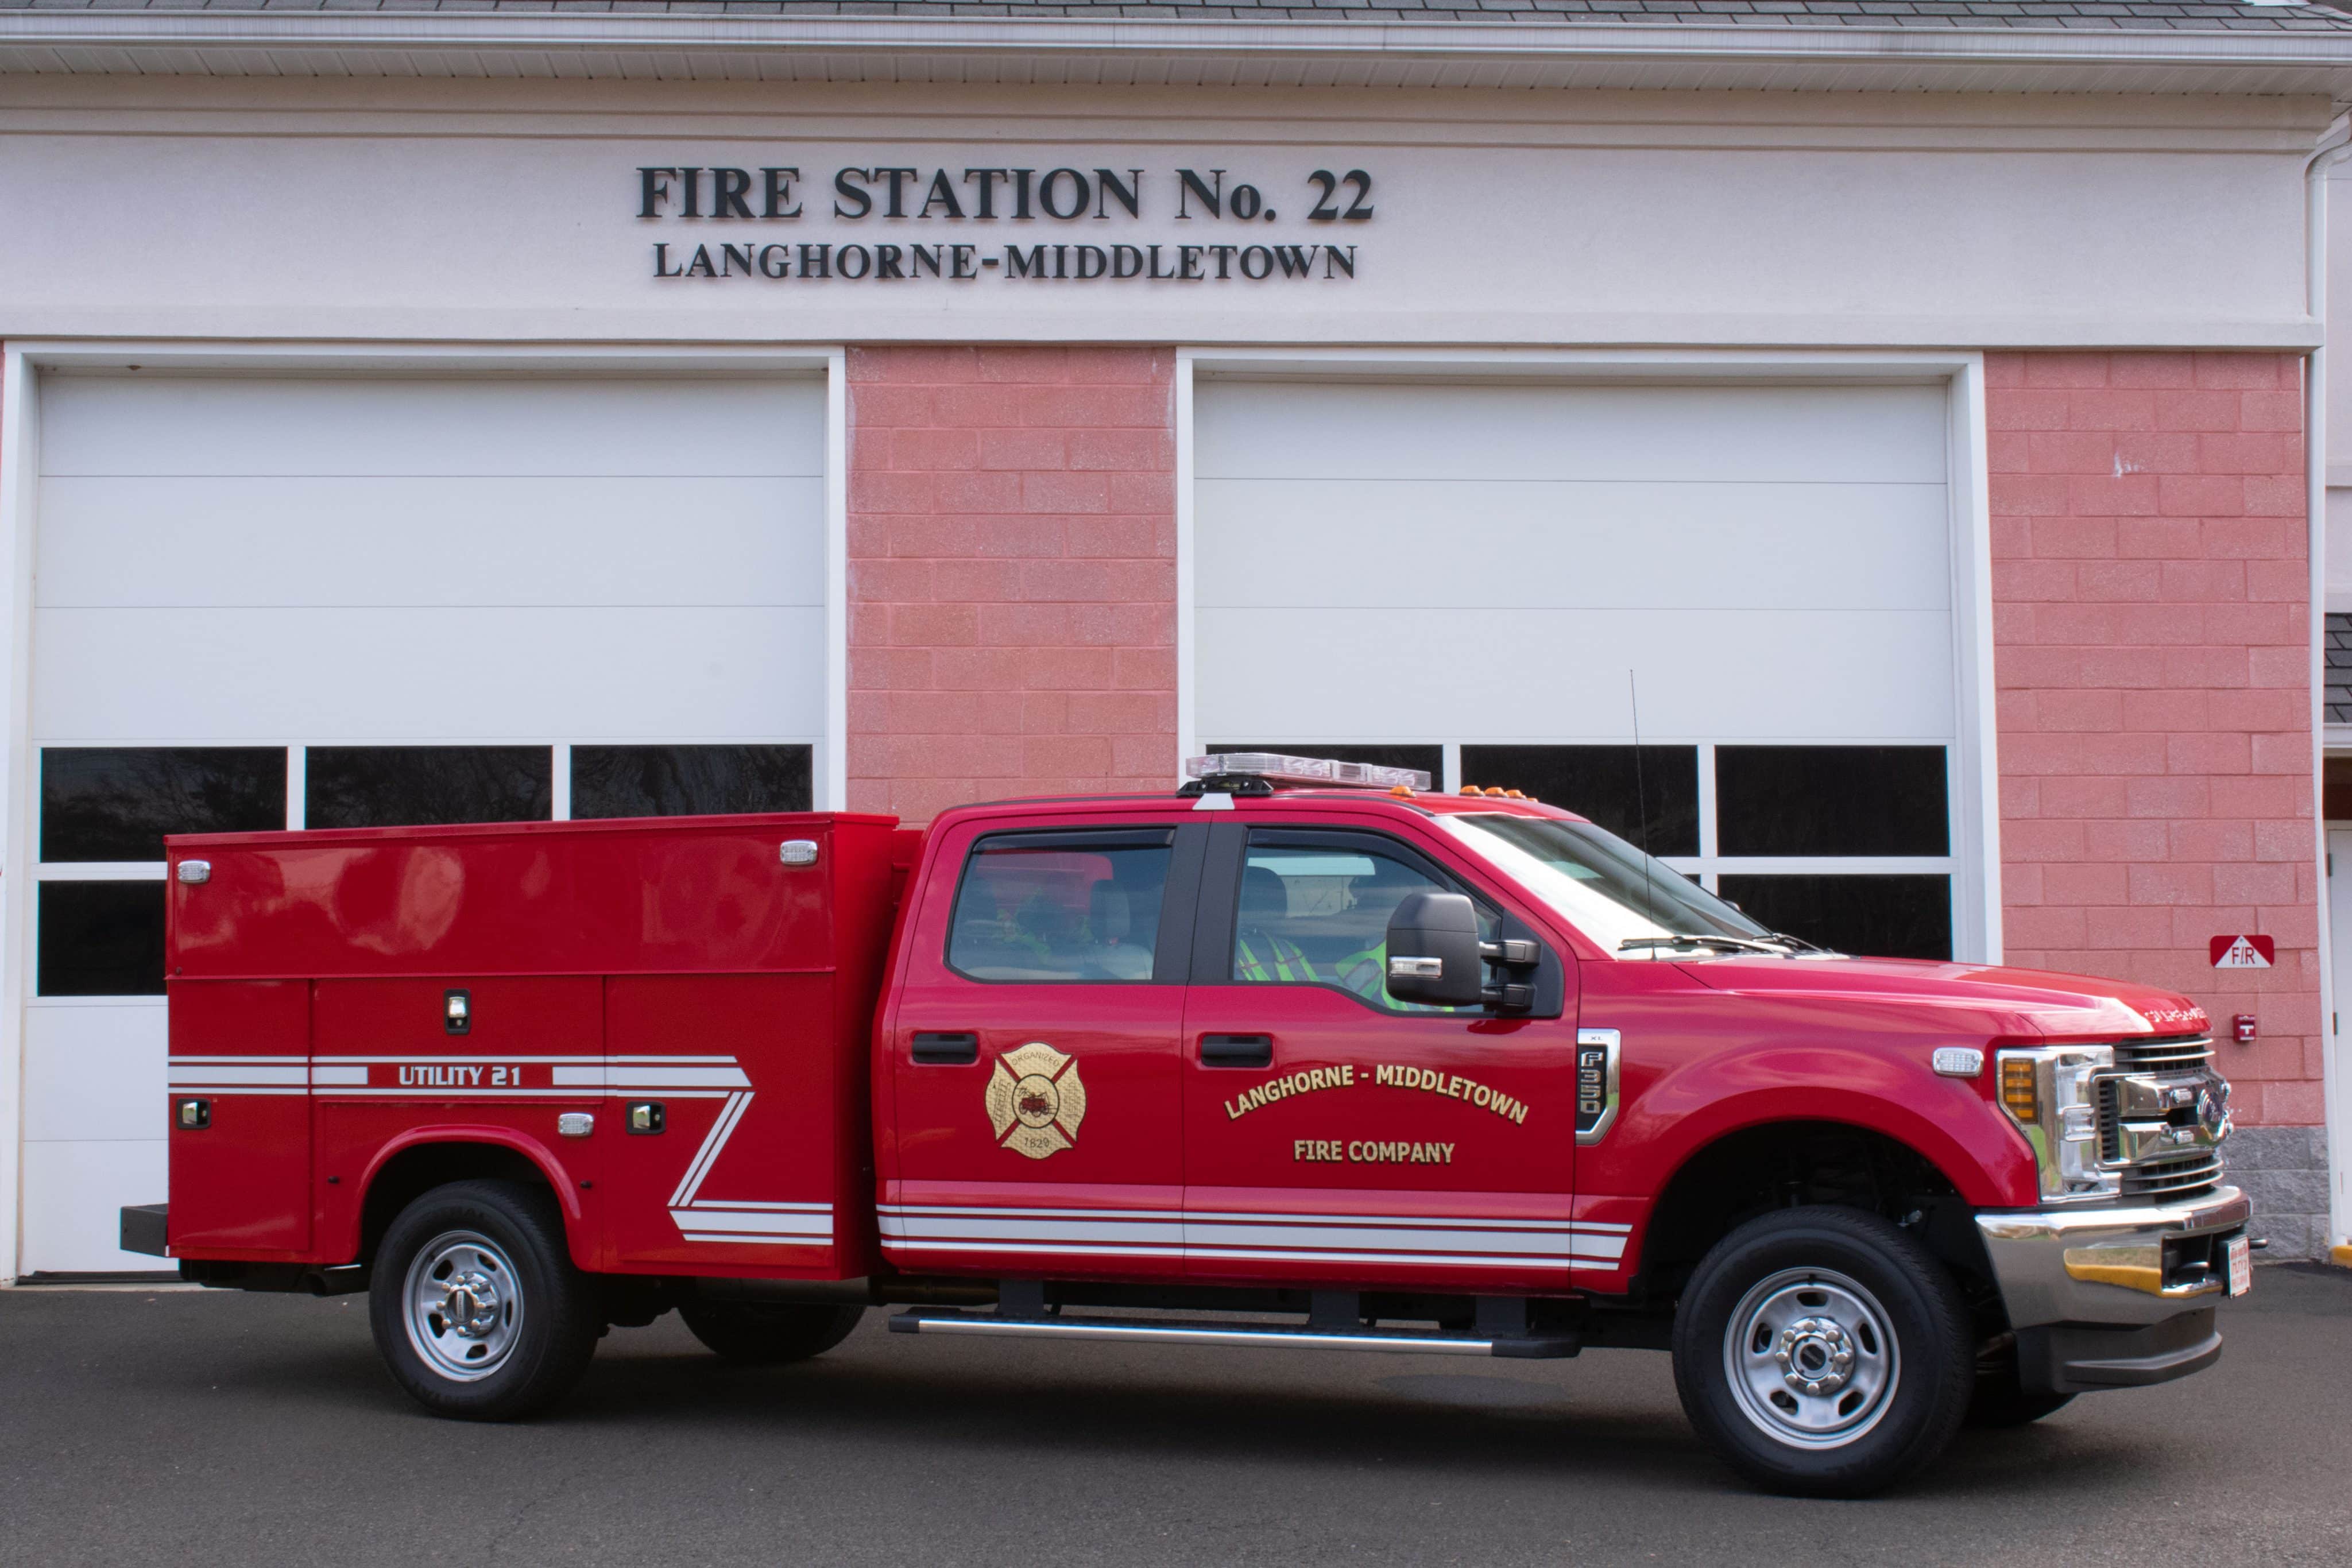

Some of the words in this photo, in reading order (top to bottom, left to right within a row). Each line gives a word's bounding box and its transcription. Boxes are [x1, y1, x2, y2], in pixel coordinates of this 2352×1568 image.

[635, 167, 803, 219] FIRE
[834, 167, 1145, 220] STATION
[1174, 169, 1276, 221] No.
[1306, 169, 1375, 221] 22
[653, 243, 1357, 280] LANGHORNE-MIDDLETOWN
[1011, 1051, 1060, 1067] ORGANIZED
[399, 1066, 483, 1086] UTILITY
[491, 1066, 520, 1086] 21
[1580, 1052, 1603, 1114] F350
[1224, 1064, 1354, 1120] LANGHORNE
[1376, 1064, 1529, 1125] MIDDLETOWN
[1024, 1137, 1050, 1148] 1829
[1294, 1140, 1343, 1161] FIRE
[1348, 1141, 1455, 1163] COMPANY
